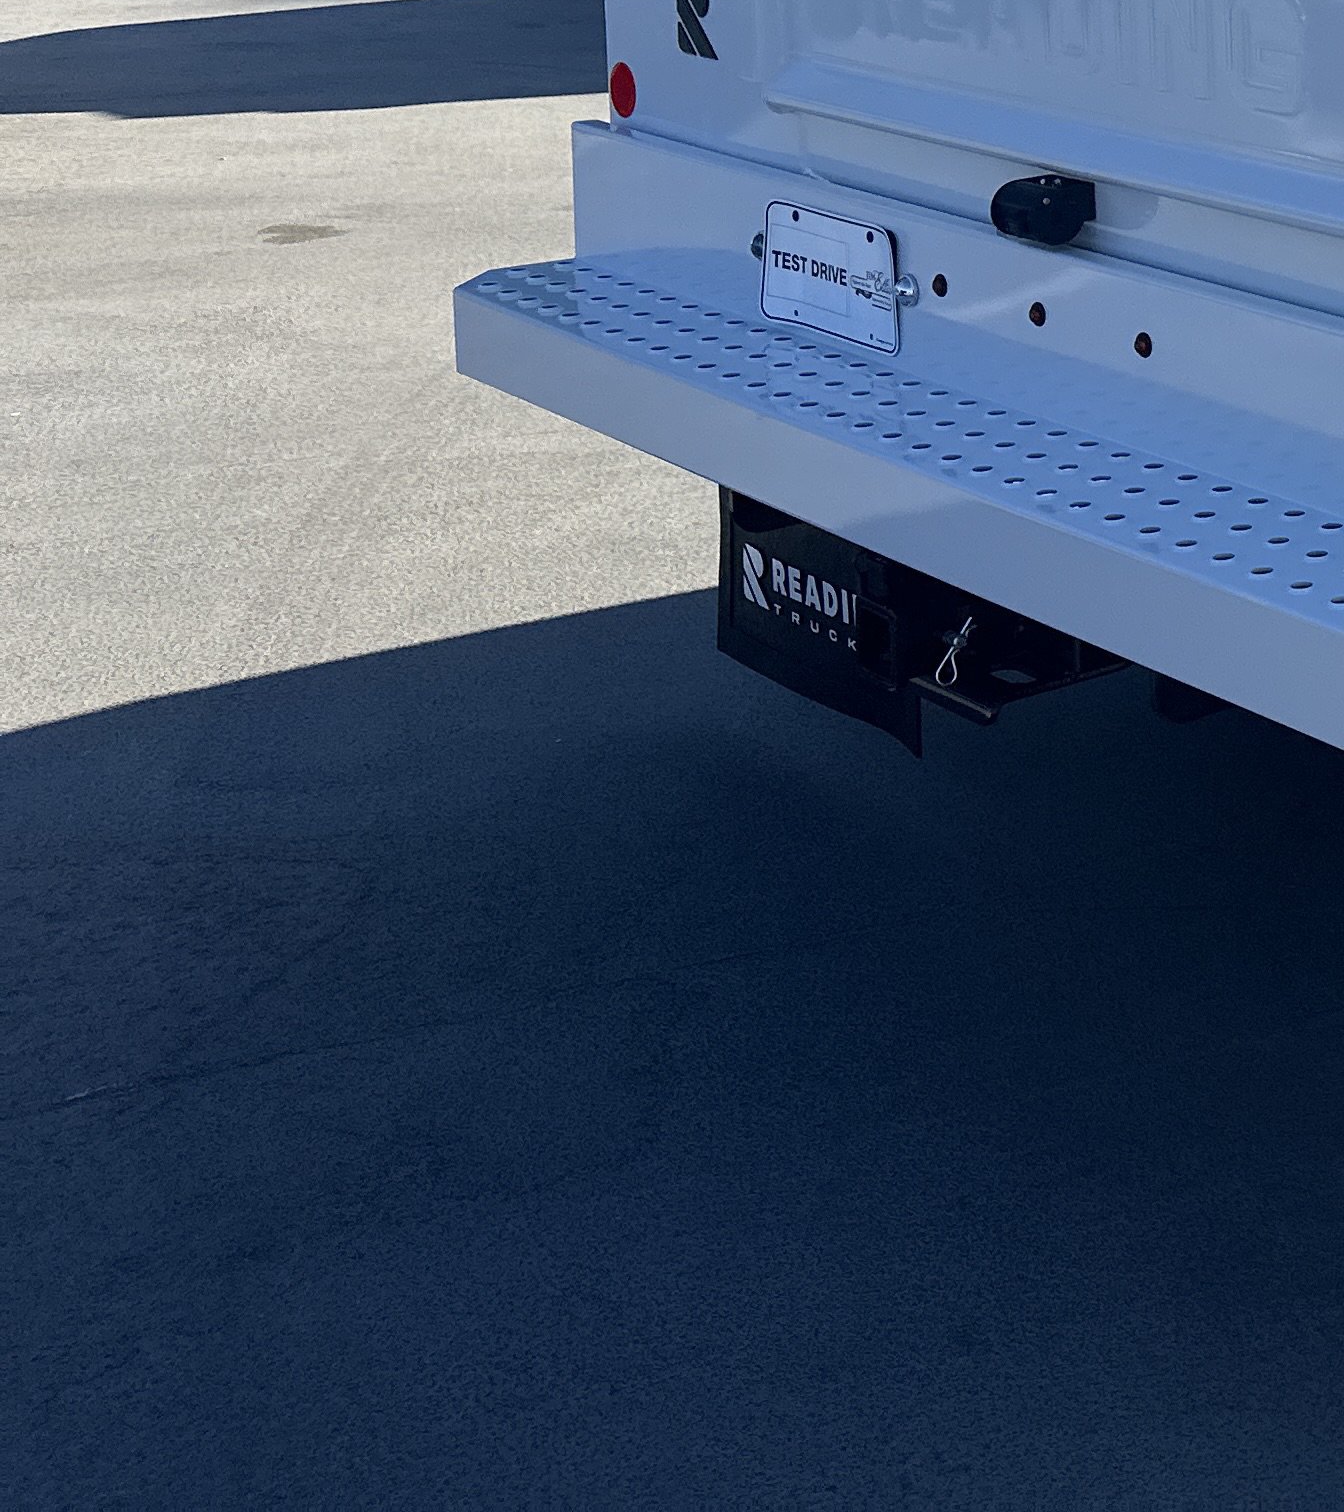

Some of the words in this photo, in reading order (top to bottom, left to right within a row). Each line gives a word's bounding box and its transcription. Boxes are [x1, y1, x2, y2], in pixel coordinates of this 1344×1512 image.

[771, 249, 808, 274] TEST
[811, 259, 848, 287] DRIVE
[771, 557, 857, 627] READI
[774, 603, 857, 652] TRUCK
